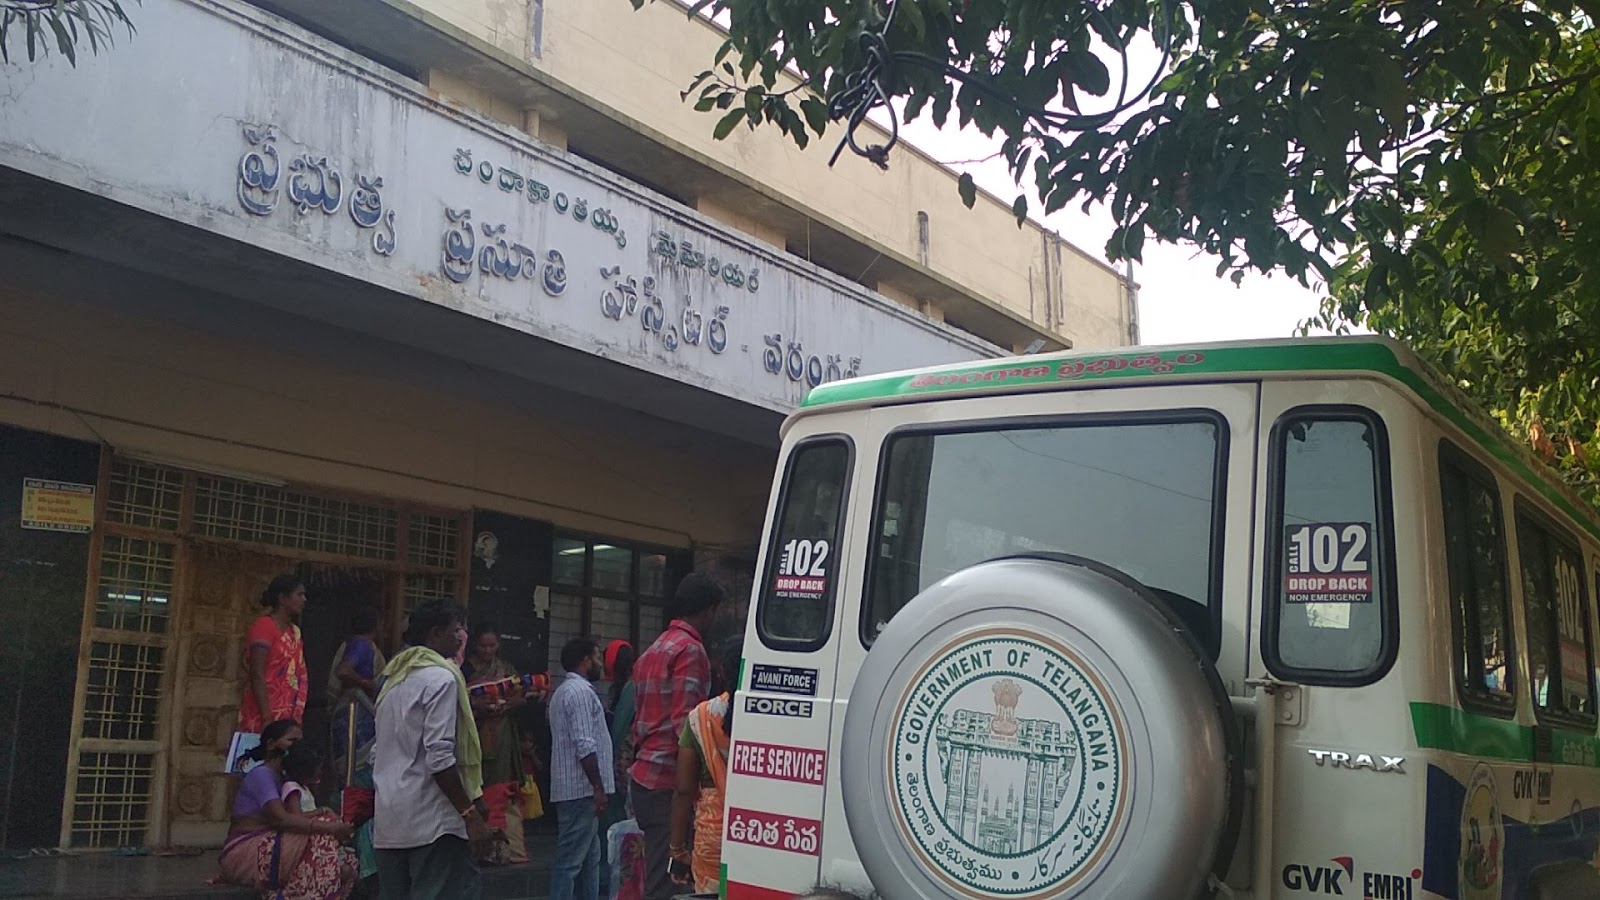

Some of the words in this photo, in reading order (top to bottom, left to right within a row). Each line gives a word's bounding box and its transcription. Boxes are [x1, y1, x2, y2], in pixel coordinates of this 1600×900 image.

[454, 147, 627, 249] చందాకాంతయ్య
[236, 126, 399, 257] ప్రభుత్వ
[441, 208, 568, 297] ప్రసూతి
[600, 264, 731, 354] హాస్పిటల్
[909, 365, 1050, 389] తెలంగాణ
[1057, 352, 1206, 379] ప్రభుత్వం
[779, 553, 788, 575] CALL
[785, 539, 829, 576] 102
[1289, 545, 1298, 573] CALL
[1291, 524, 1368, 573] 102
[777, 579, 800, 590] DROP
[800, 580, 824, 591] BACK
[1289, 578, 1326, 591] DROP
[1328, 577, 1368, 591] BACK
[1289, 594, 1309, 602] NON
[1310, 593, 1367, 602] EMERGENCY
[757, 671, 782, 685] AVANI
[783, 674, 811, 688] FORCE
[746, 698, 811, 716] FORCE
[906, 649, 993, 746] GOVERNMENT
[1006, 649, 1031, 669] OF
[1044, 660, 1109, 772] TELANGANA
[734, 744, 764, 774] FREE
[767, 747, 824, 781] SERVICE
[1308, 748, 1407, 774] TRAX
[1513, 770, 1532, 799] GVK
[730, 815, 779, 846] ఉచిత
[783, 819, 818, 853] సేవ
[906, 771, 937, 837] తెలంగాణ
[933, 837, 1003, 881] ప్రభుత్వము
[1282, 864, 1344, 895] GVK
[1363, 872, 1412, 900] EMRI
